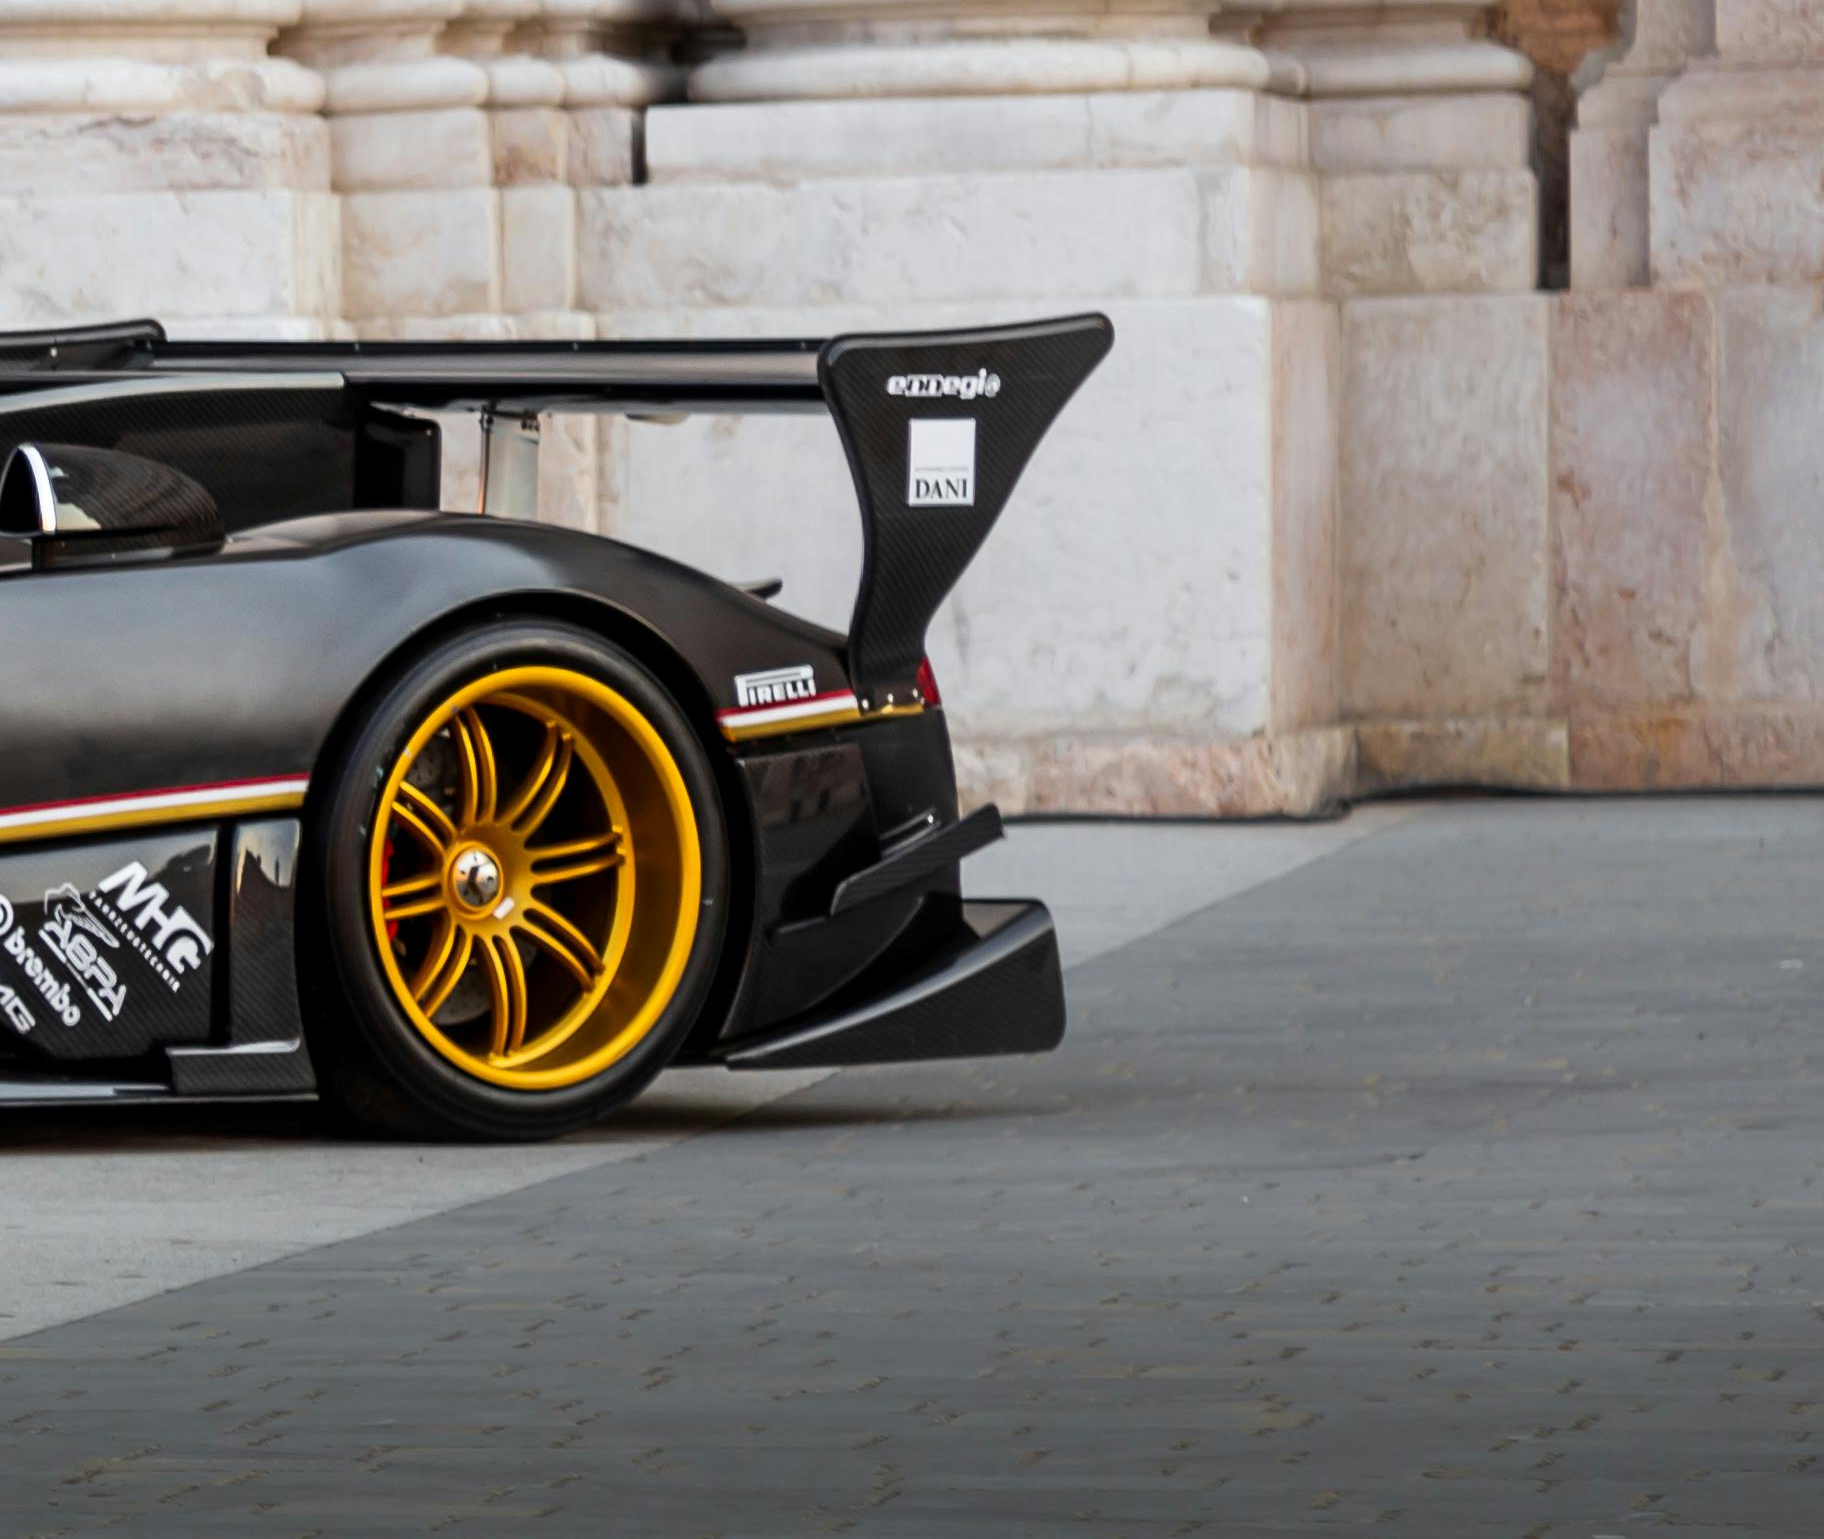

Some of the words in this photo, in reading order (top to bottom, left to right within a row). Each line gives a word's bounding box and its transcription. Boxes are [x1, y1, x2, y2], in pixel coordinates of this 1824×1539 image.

[915, 478, 967, 499] DANI
[734, 664, 817, 707] PIRELLI
[3, 925, 81, 1027] brembo
